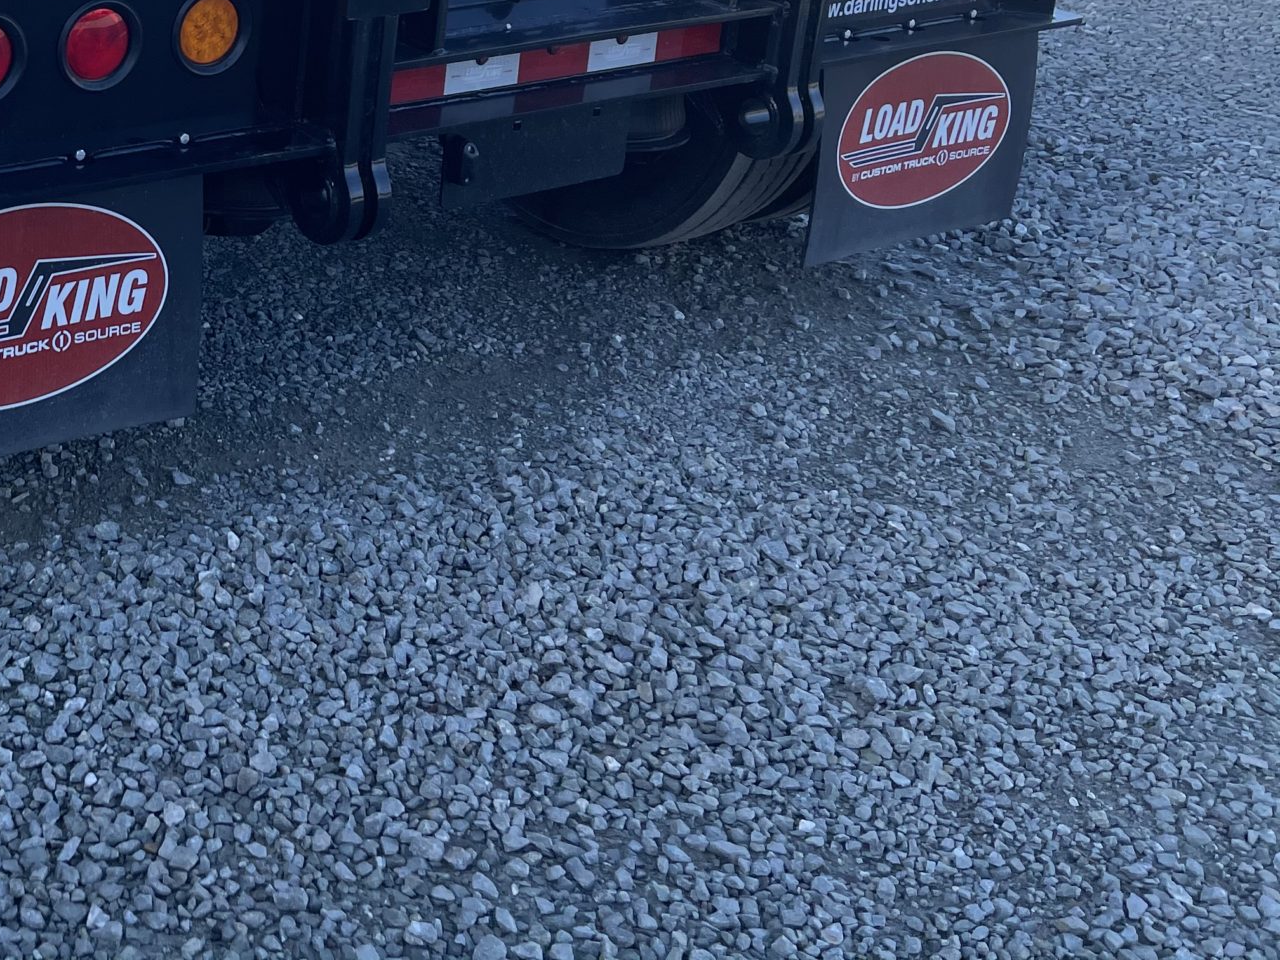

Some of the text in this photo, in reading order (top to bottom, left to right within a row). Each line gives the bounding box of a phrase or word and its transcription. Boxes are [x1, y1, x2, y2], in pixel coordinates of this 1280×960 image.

[859, 99, 999, 148] LOAD KING
[851, 172, 861, 182] BY
[861, 163, 901, 179] CUSTOM
[904, 155, 936, 169] TRUCK
[949, 146, 991, 161] SOURCE
[40, 269, 148, 330] KING
[73, 321, 142, 344] SOURCE
